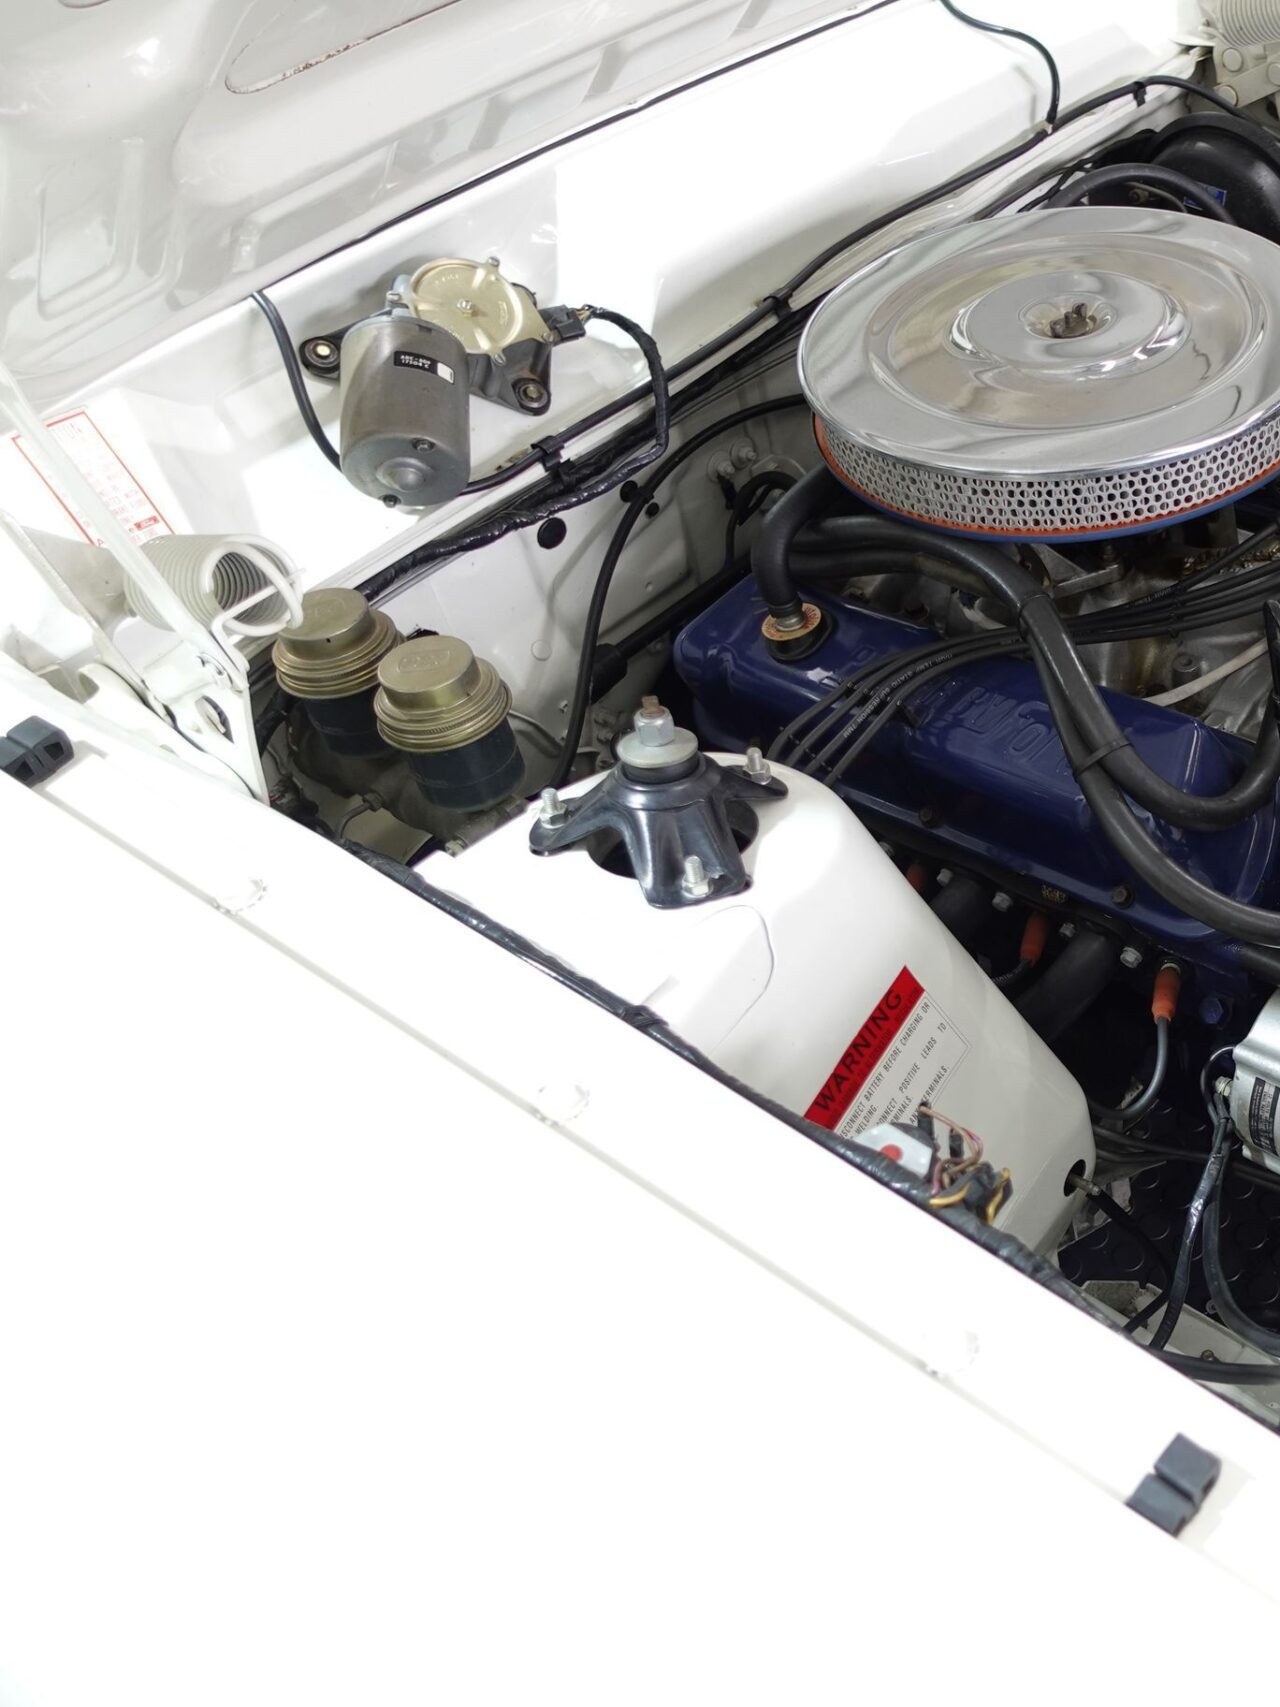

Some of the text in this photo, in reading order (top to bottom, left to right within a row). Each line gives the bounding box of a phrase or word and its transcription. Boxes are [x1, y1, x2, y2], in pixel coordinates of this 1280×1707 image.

[815, 989, 902, 1112] WARNING
[840, 1001, 931, 1138] ISCONNECT BATTERY BEFORE CHARGING OR
[899, 1062, 921, 1094] POSITIVE
[921, 1036, 938, 1060] LEADS
[937, 1022, 947, 1034] TO
